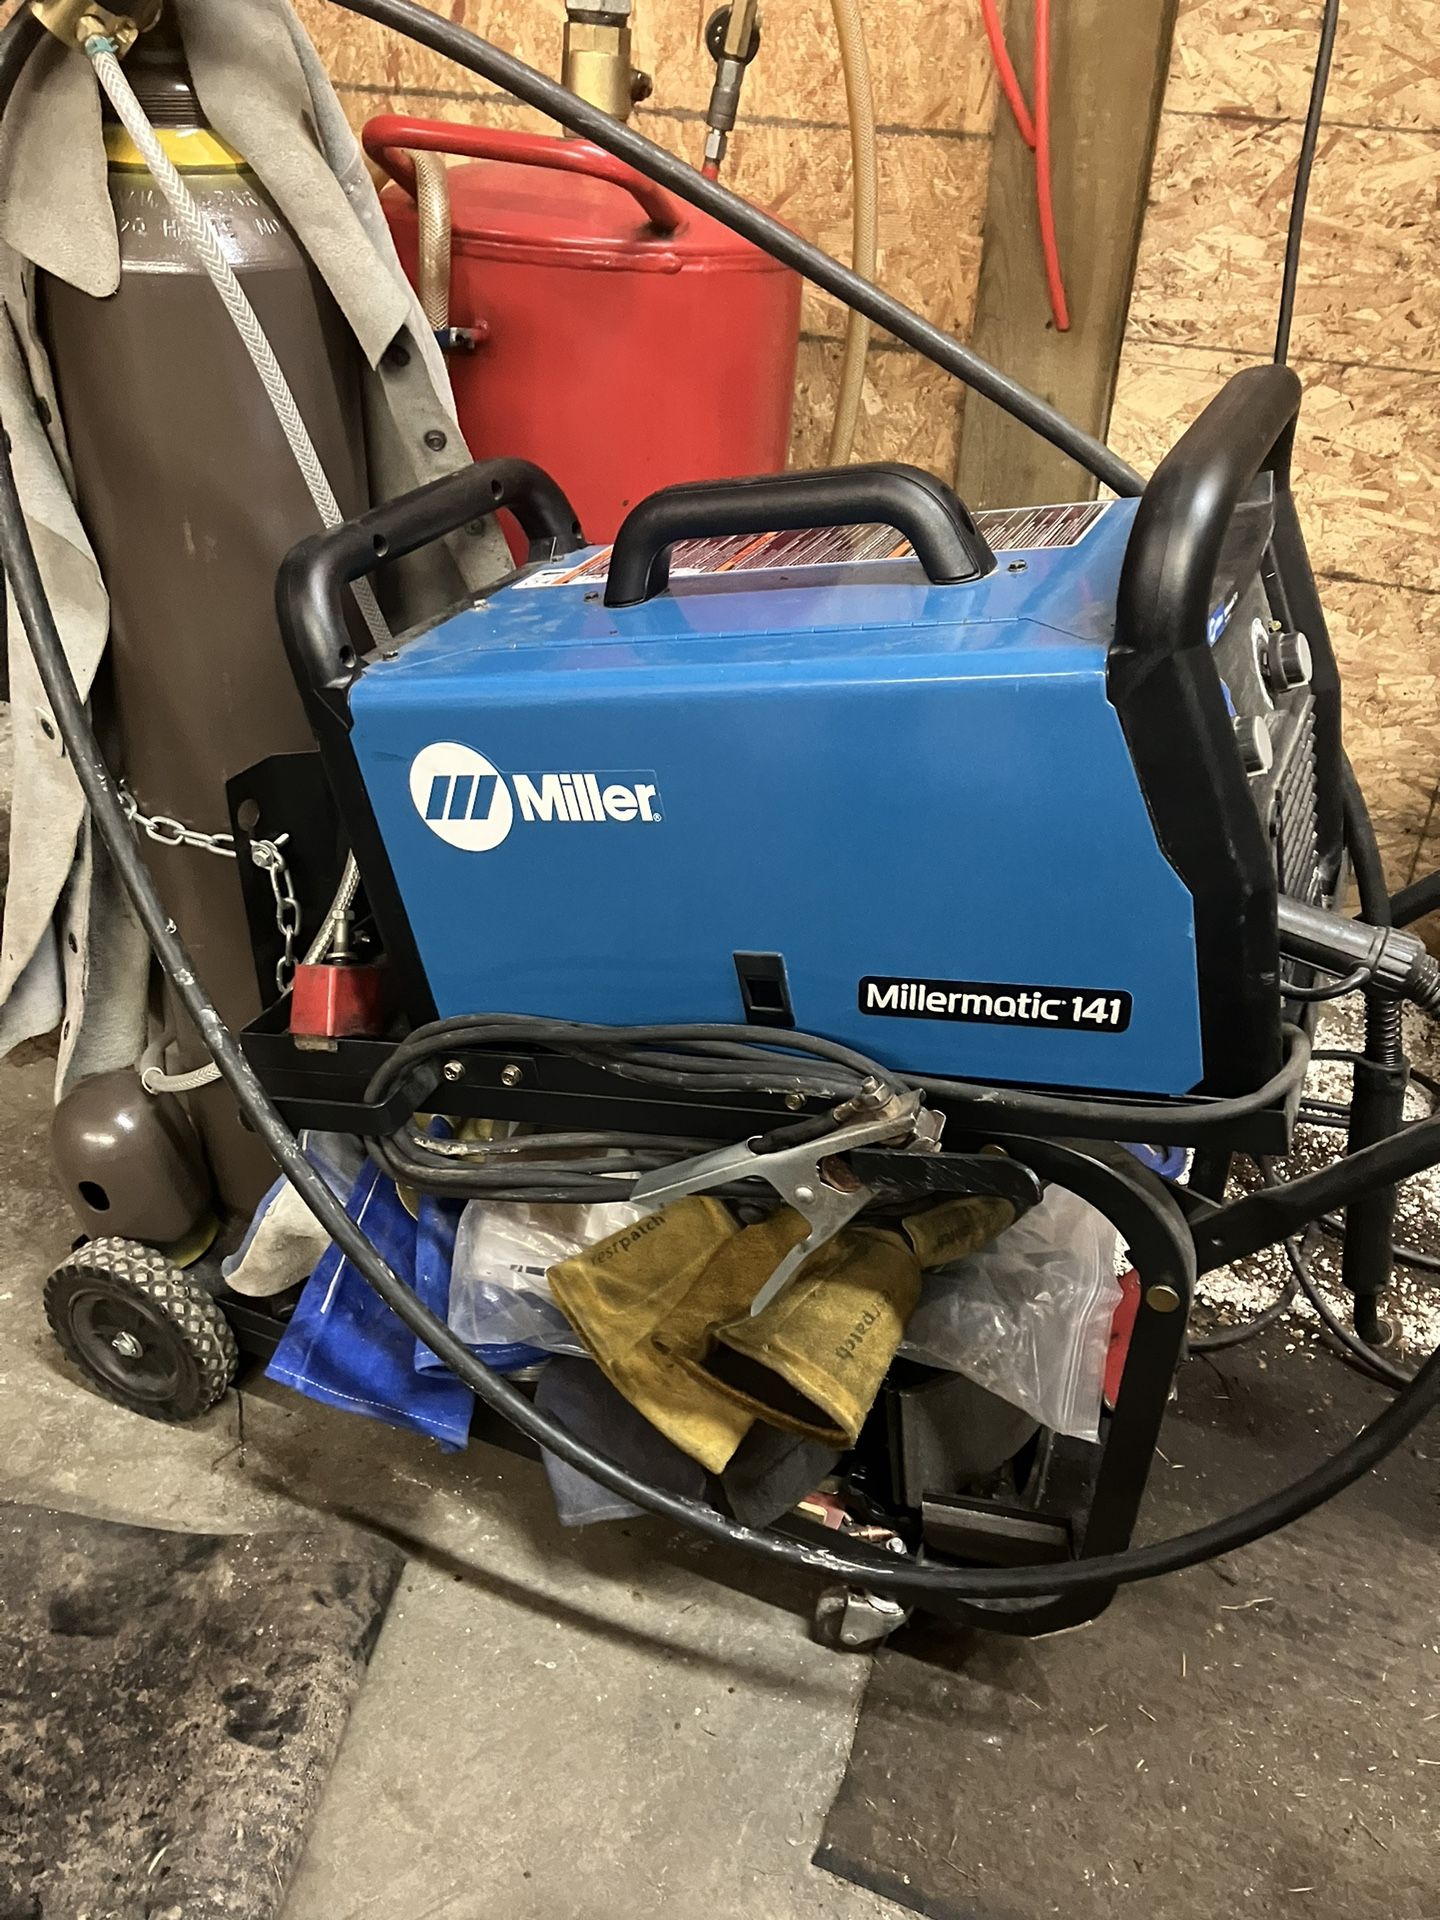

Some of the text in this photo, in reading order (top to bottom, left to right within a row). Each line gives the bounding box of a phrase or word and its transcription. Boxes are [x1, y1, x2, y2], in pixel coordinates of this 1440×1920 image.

[512, 773, 656, 822] Miller
[866, 983, 1122, 1025] Millermatic 141
